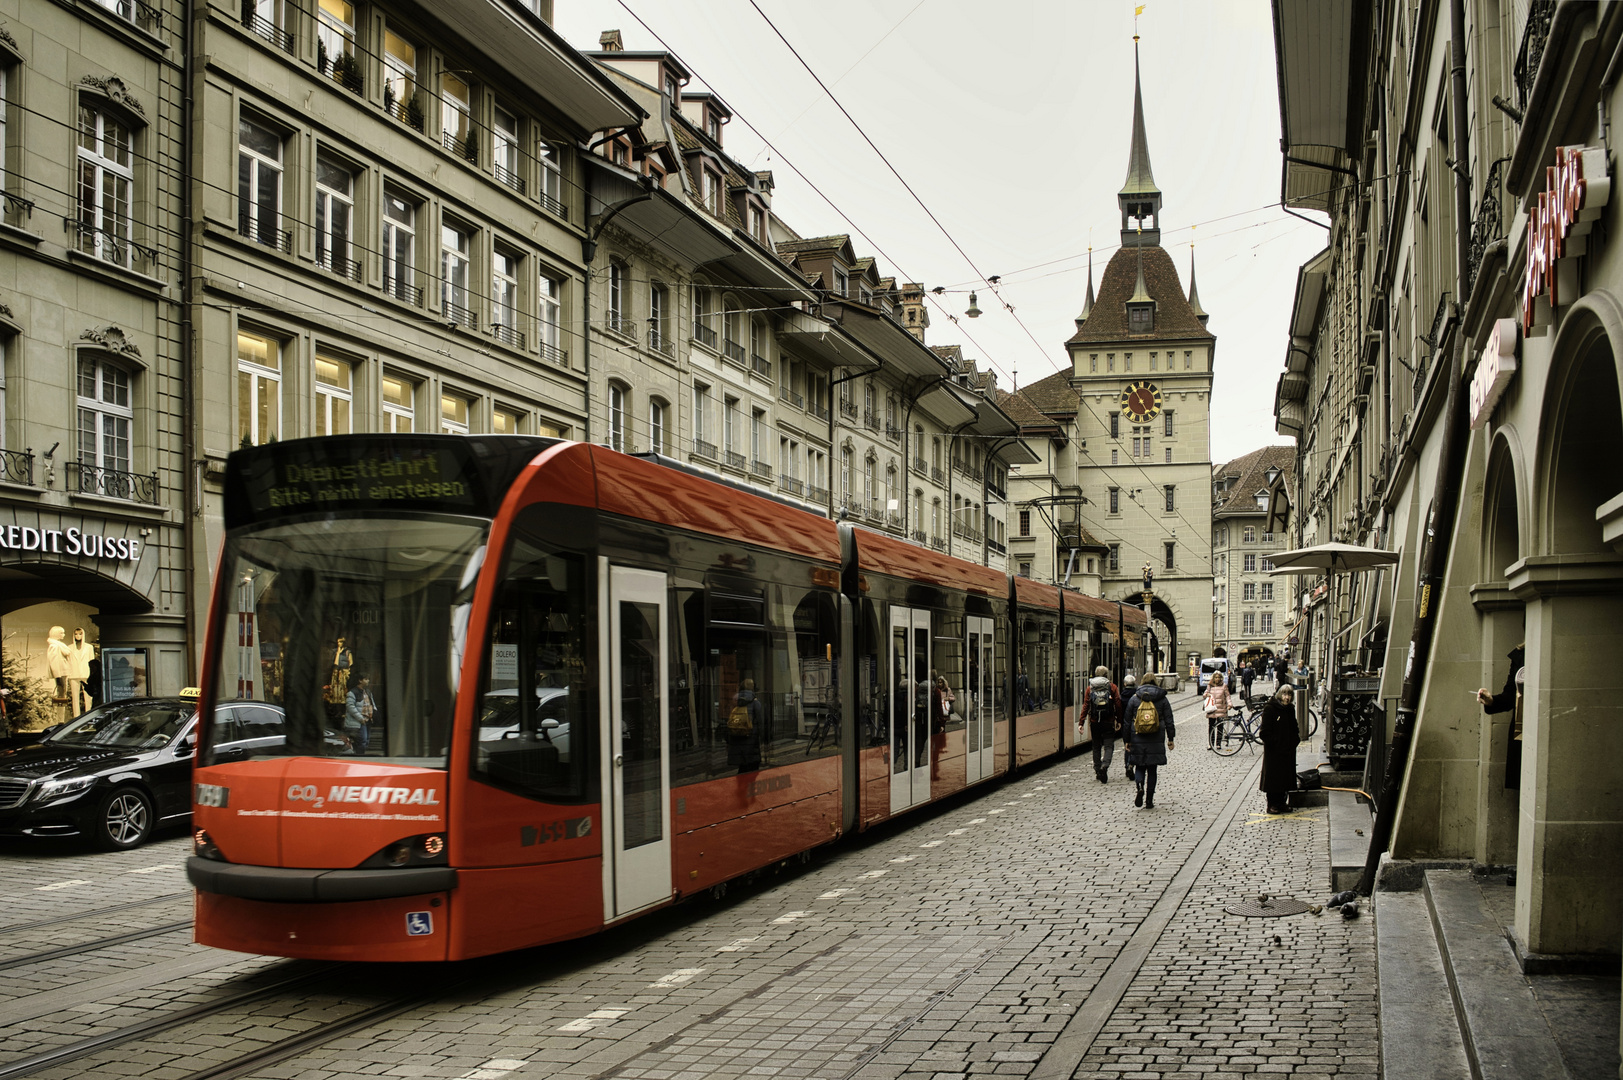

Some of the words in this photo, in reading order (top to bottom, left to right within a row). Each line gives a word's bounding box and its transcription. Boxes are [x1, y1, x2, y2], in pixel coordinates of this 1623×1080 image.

[268, 488, 312, 508] Bitte
[318, 484, 361, 502] nicht
[368, 478, 465, 501] einsteigen
[496, 650, 516, 658] BOLERO
[327, 785, 440, 806] NEUTRAL
